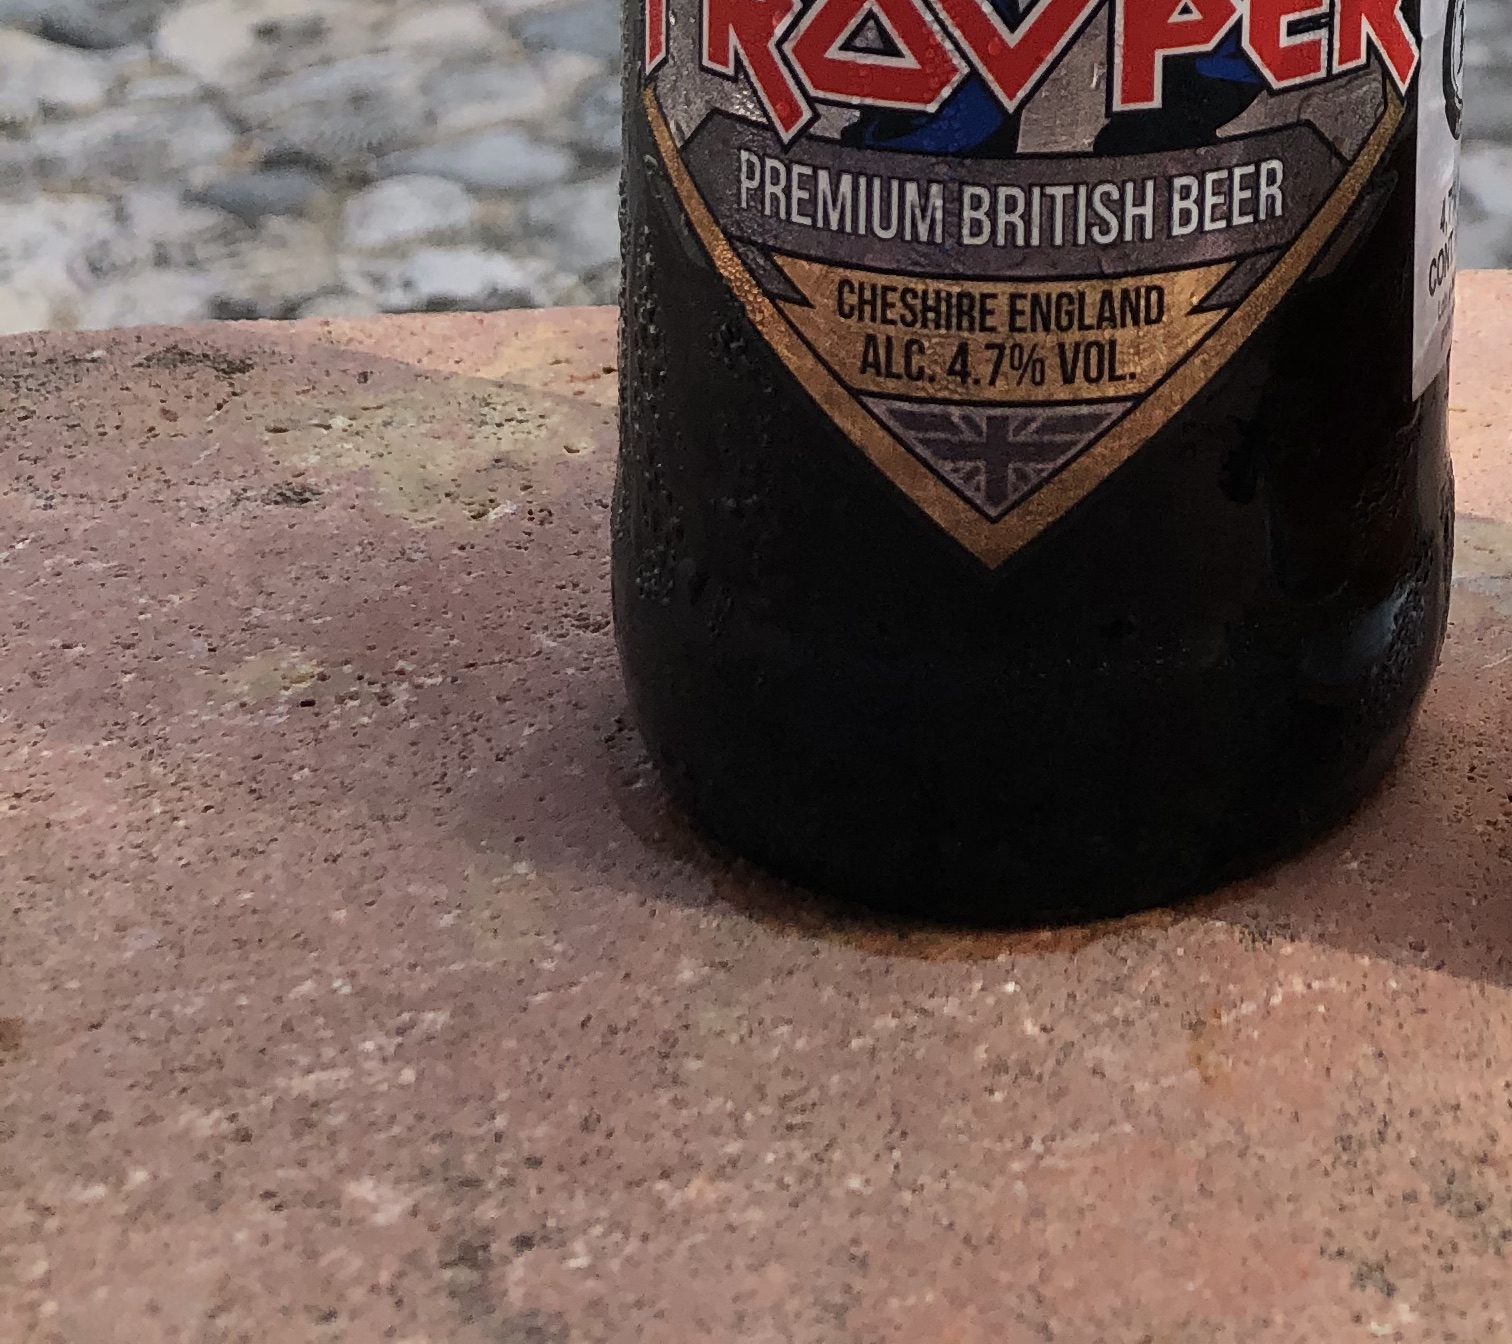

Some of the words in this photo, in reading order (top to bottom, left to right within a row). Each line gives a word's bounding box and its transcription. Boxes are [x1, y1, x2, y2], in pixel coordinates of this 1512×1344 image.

[738, 148, 944, 245] PREMIUM
[961, 181, 1156, 247] BRITISH
[1169, 157, 1285, 237] BEER
[836, 278, 998, 334] CHESHIRE
[1008, 284, 1166, 330] ENGLAND
[860, 333, 937, 382] ALC.
[947, 339, 1046, 387] 4.7%
[1057, 339, 1138, 385] VOL.
